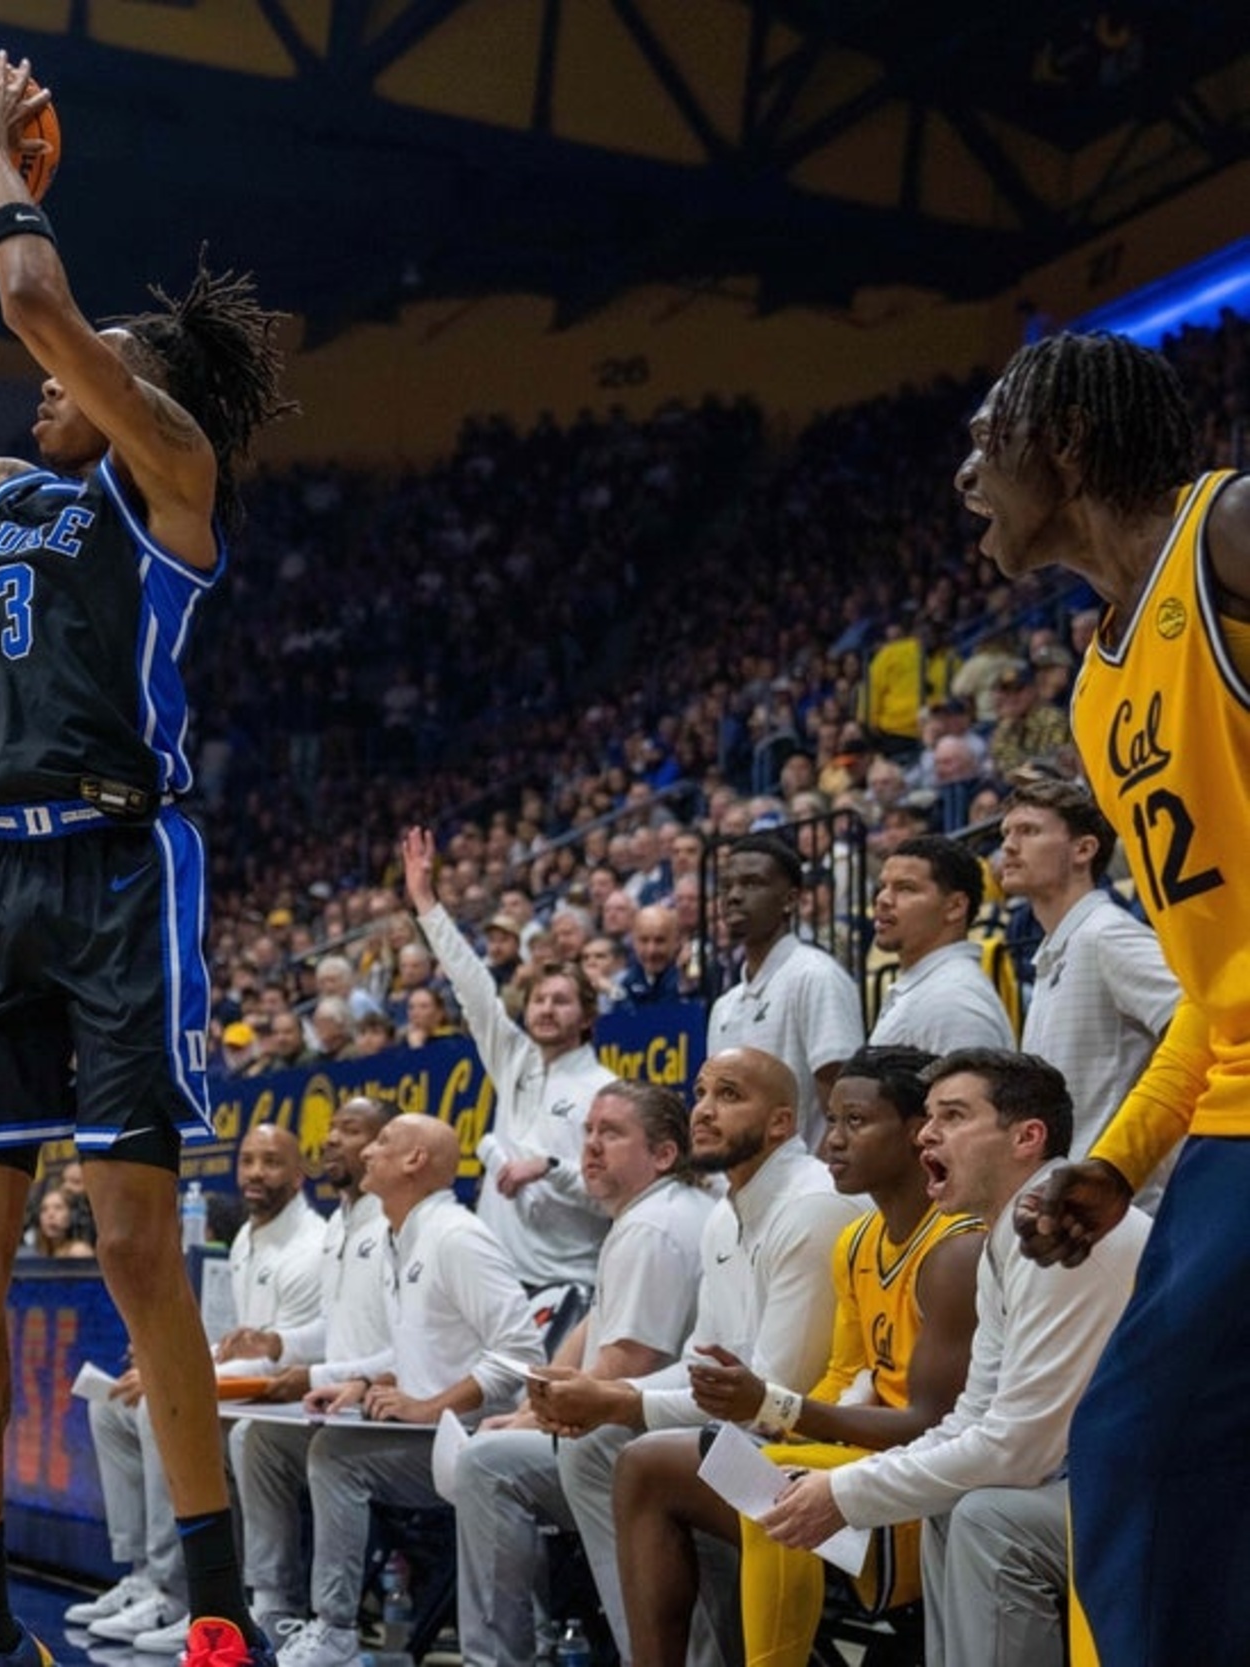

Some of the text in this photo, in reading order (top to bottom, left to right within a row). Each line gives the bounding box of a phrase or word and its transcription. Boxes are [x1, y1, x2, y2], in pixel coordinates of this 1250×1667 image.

[1108, 690, 1172, 798] Cal
[1133, 788, 1226, 912] 12
[646, 1032, 689, 1085] Cal
